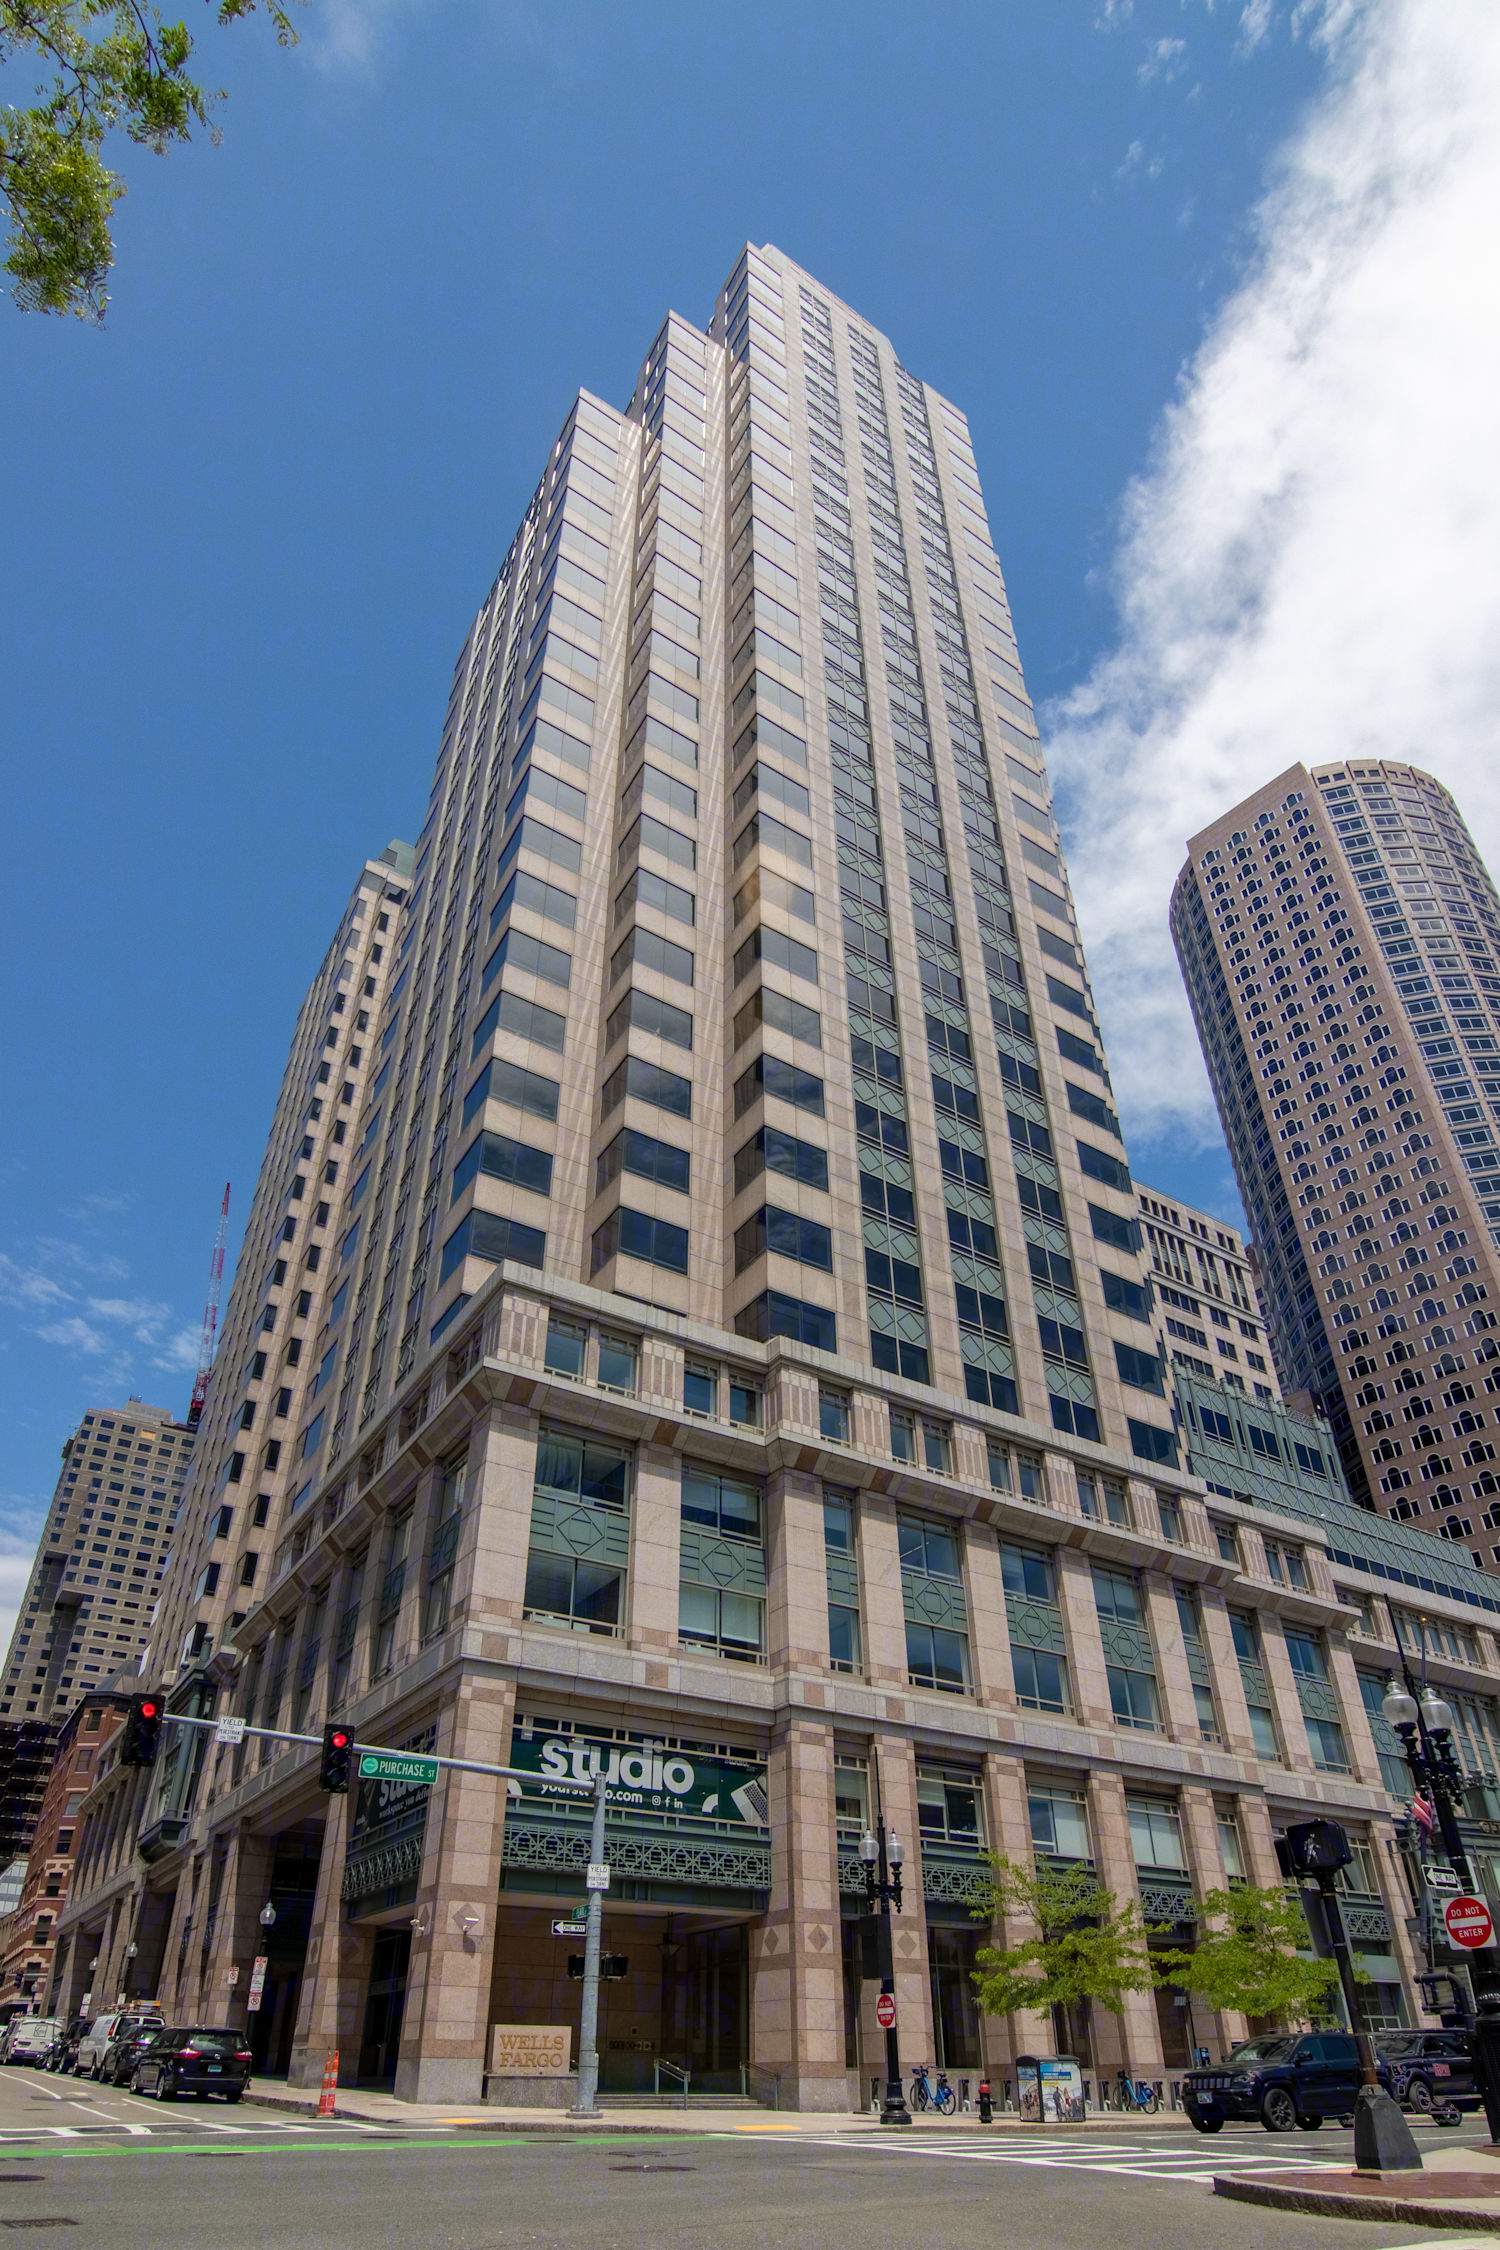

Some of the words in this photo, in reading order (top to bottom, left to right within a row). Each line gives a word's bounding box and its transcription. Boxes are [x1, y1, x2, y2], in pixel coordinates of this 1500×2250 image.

[223, 1718, 243, 1726] YIELD
[379, 1760, 426, 1777] PURCHASE
[428, 1769, 435, 1778] ST
[540, 1738, 695, 1795] studio
[1433, 1872, 1443, 1882] ONE
[1445, 1873, 1454, 1883] WAY
[1451, 1909, 1462, 1918] DO
[1465, 1906, 1480, 1916] NOT
[1458, 1928, 1484, 1938] ENTER
[500, 2034, 565, 2050] WELLS
[500, 2052, 563, 2068] FARGO
